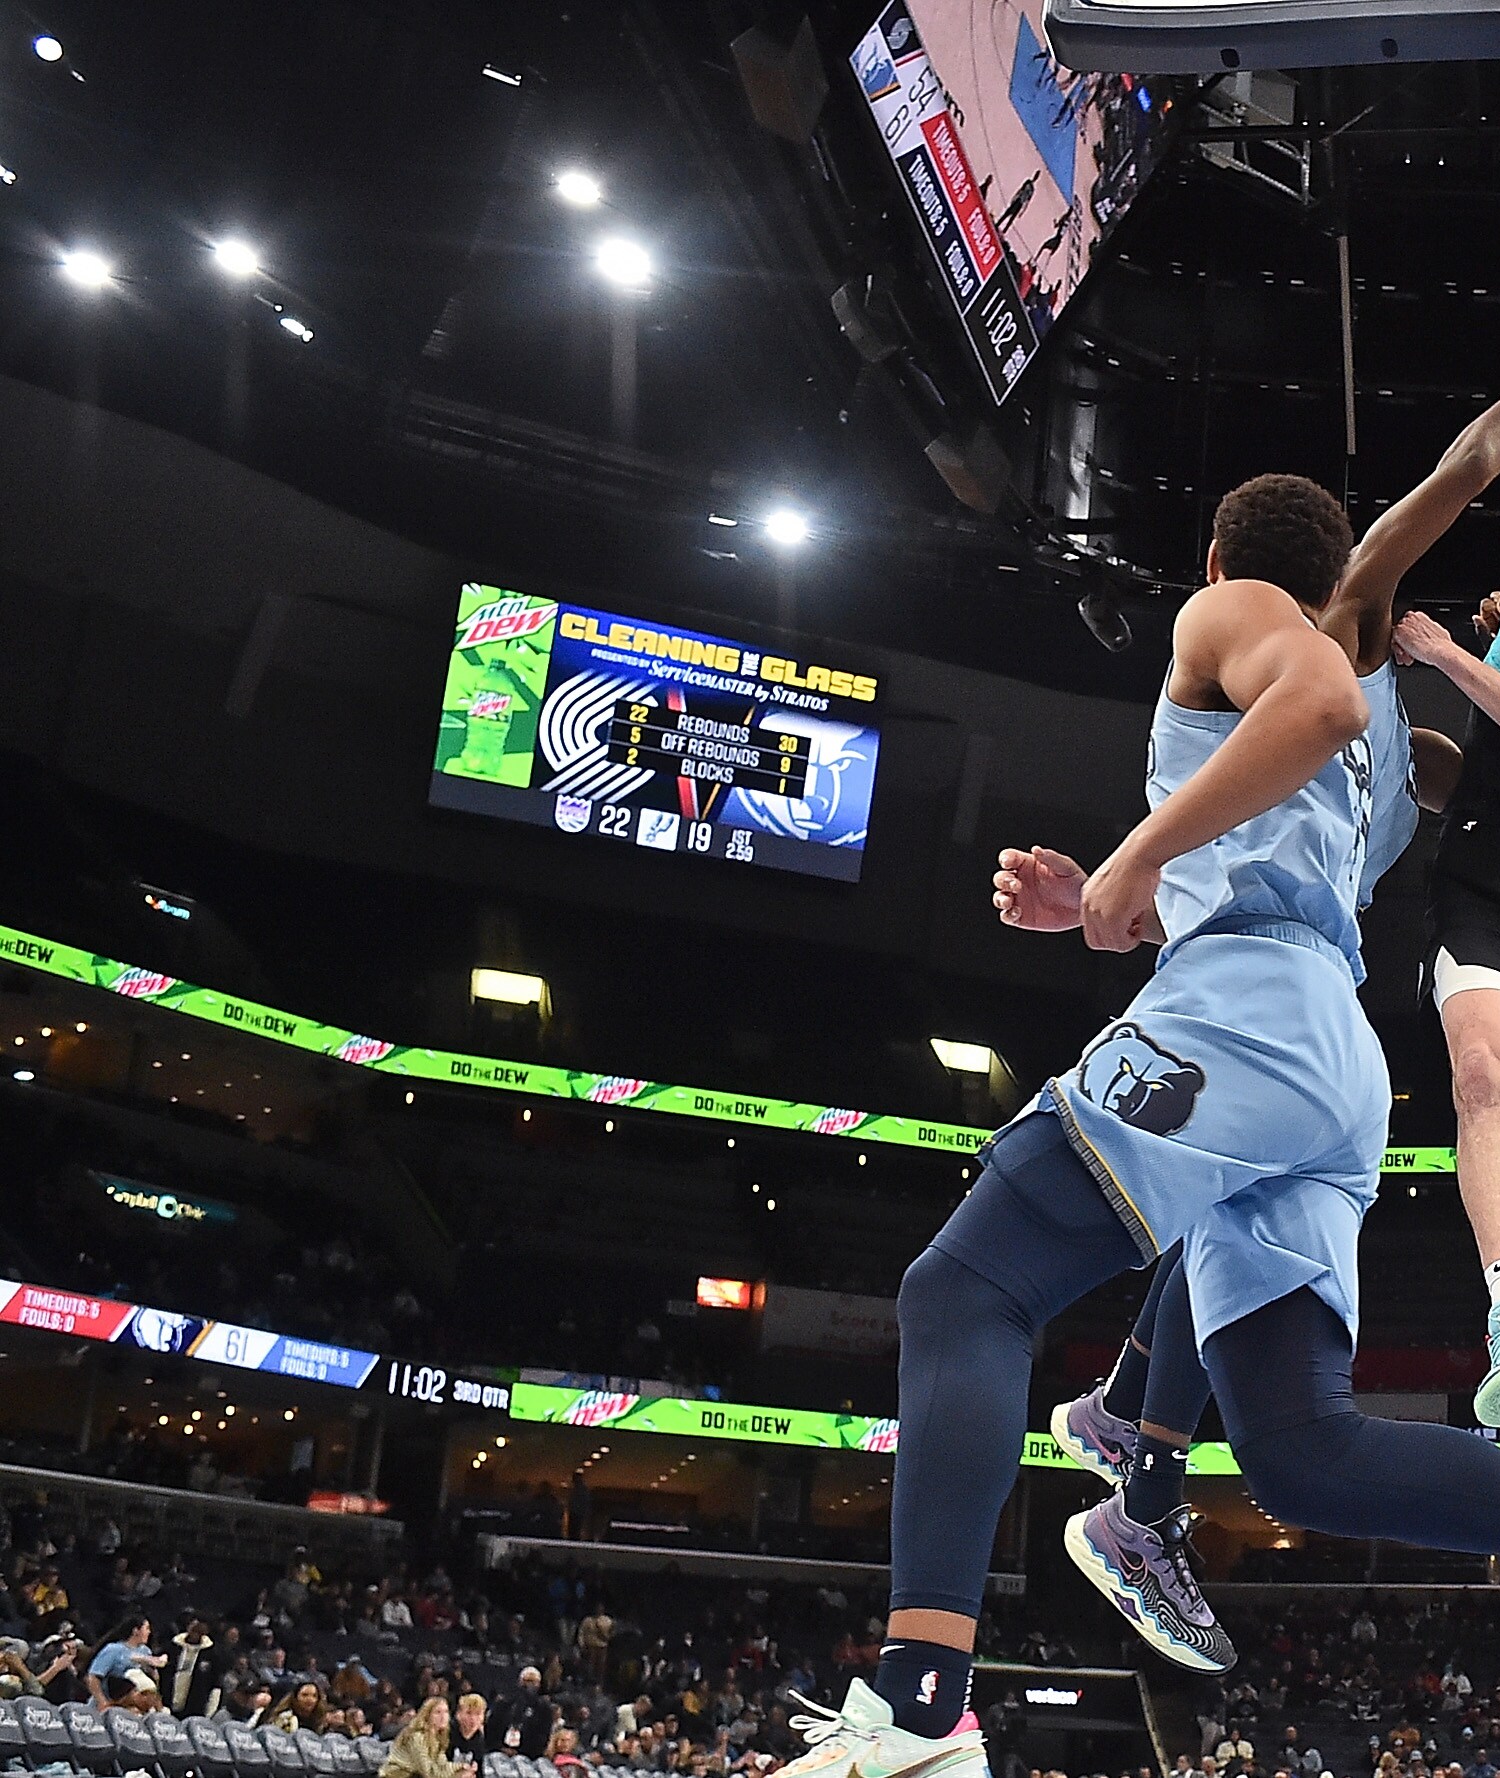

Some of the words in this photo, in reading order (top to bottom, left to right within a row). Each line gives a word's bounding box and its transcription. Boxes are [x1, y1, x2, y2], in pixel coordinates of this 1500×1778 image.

[908, 66, 938, 117] 54
[885, 105, 913, 149] 61
[932, 120, 967, 194] TIMEOUTS:
[957, 183, 972, 203] 5
[966, 207, 991, 259] FOULS:
[983, 246, 996, 264] 0
[908, 154, 943, 227] TIMEOUTS:
[934, 220, 949, 236] 5
[961, 278, 974, 297] 0
[981, 288, 1018, 357] 11:02
[559, 612, 741, 673] CLEANING
[741, 650, 760, 676] THE
[760, 655, 878, 702] GLASS
[755, 686, 769, 703] by
[769, 686, 830, 712] STRATOS
[629, 705, 649, 723] 22
[677, 714, 750, 744] REBOUNDS
[778, 735, 798, 753] 30
[630, 727, 641, 744] 5
[661, 733, 686, 753] OFF
[690, 737, 760, 767] REBOUNDS
[780, 756, 791, 773] 9
[626, 749, 638, 765] 2
[681, 758, 735, 783] BLOCKS
[779, 778, 786, 794] 1
[598, 805, 631, 837] 22
[687, 822, 712, 852] 19
[731, 829, 753, 846] 1ST
[15, 939, 55, 963] DEW
[223, 1002, 244, 1022] DO
[263, 1015, 297, 1037] DEW
[451, 1060, 472, 1078] DO
[493, 1066, 529, 1085] DEW
[694, 1095, 714, 1112] DO
[734, 1101, 768, 1119] DEW
[918, 1127, 937, 1143] DO
[955, 1132, 987, 1149] DEW
[1383, 1153, 1416, 1167] DEW
[24, 1288, 90, 1317] TIMEOUTS:
[19, 1308, 64, 1331] FOULS:
[64, 1315, 75, 1333] 0
[225, 1329, 248, 1362] 61
[388, 1361, 447, 1404] 11:02
[453, 1379, 481, 1404] 3RD
[482, 1385, 509, 1411] QTR
[701, 1411, 725, 1429] DO
[751, 1415, 792, 1435] DEW
[1028, 1440, 1065, 1460] DEW
